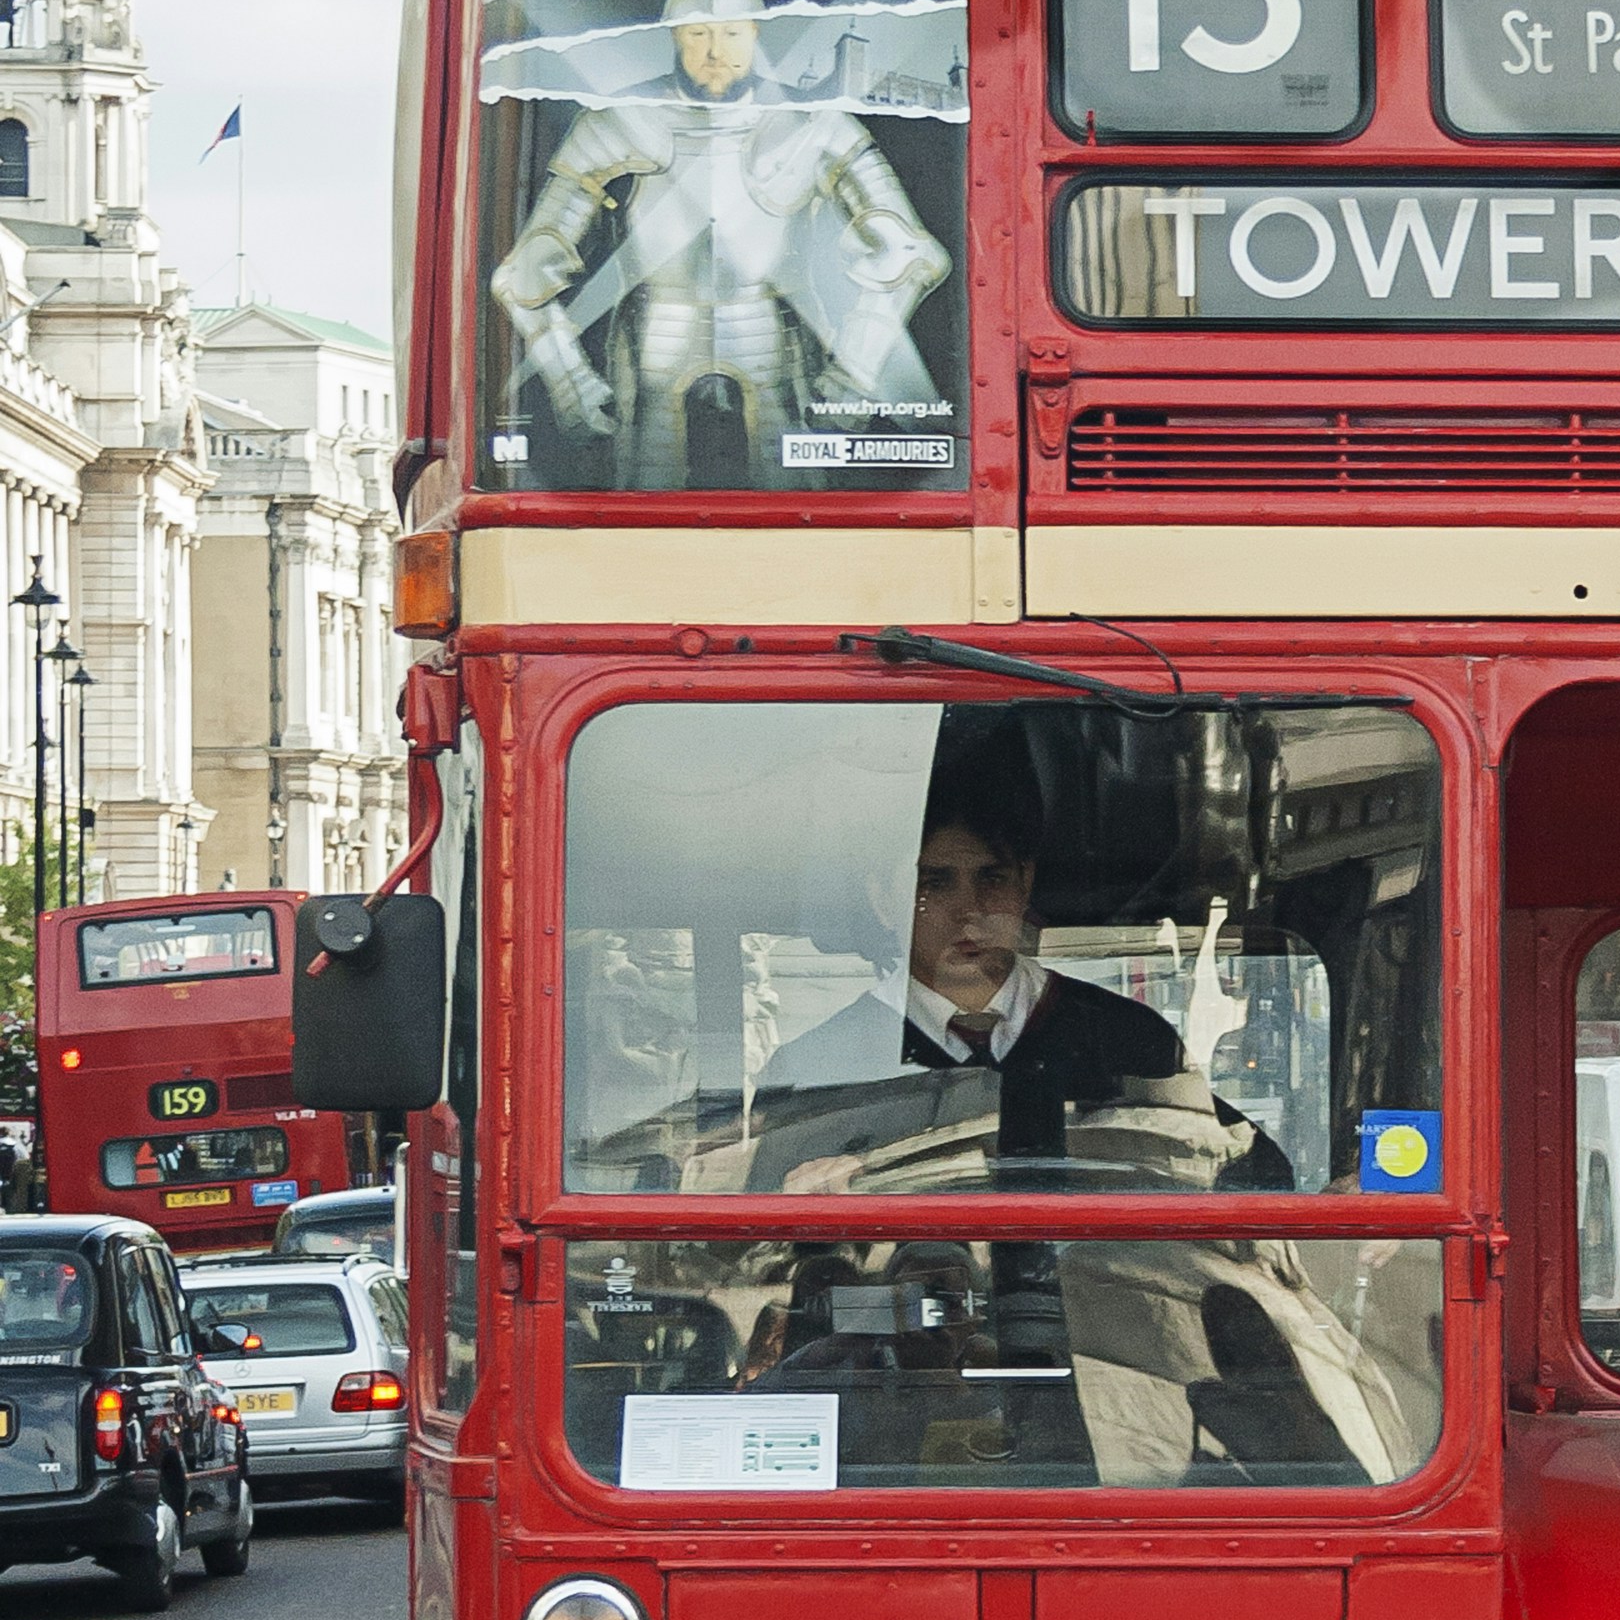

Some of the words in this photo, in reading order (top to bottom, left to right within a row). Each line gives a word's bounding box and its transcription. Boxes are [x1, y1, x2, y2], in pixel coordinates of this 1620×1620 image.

[1501, 10, 1554, 75] St
[811, 400, 953, 418] www.hrp.org.uk
[790, 442, 840, 460] ROYAL
[852, 440, 949, 462] ARMOURIES
[163, 1086, 207, 1116] 159
